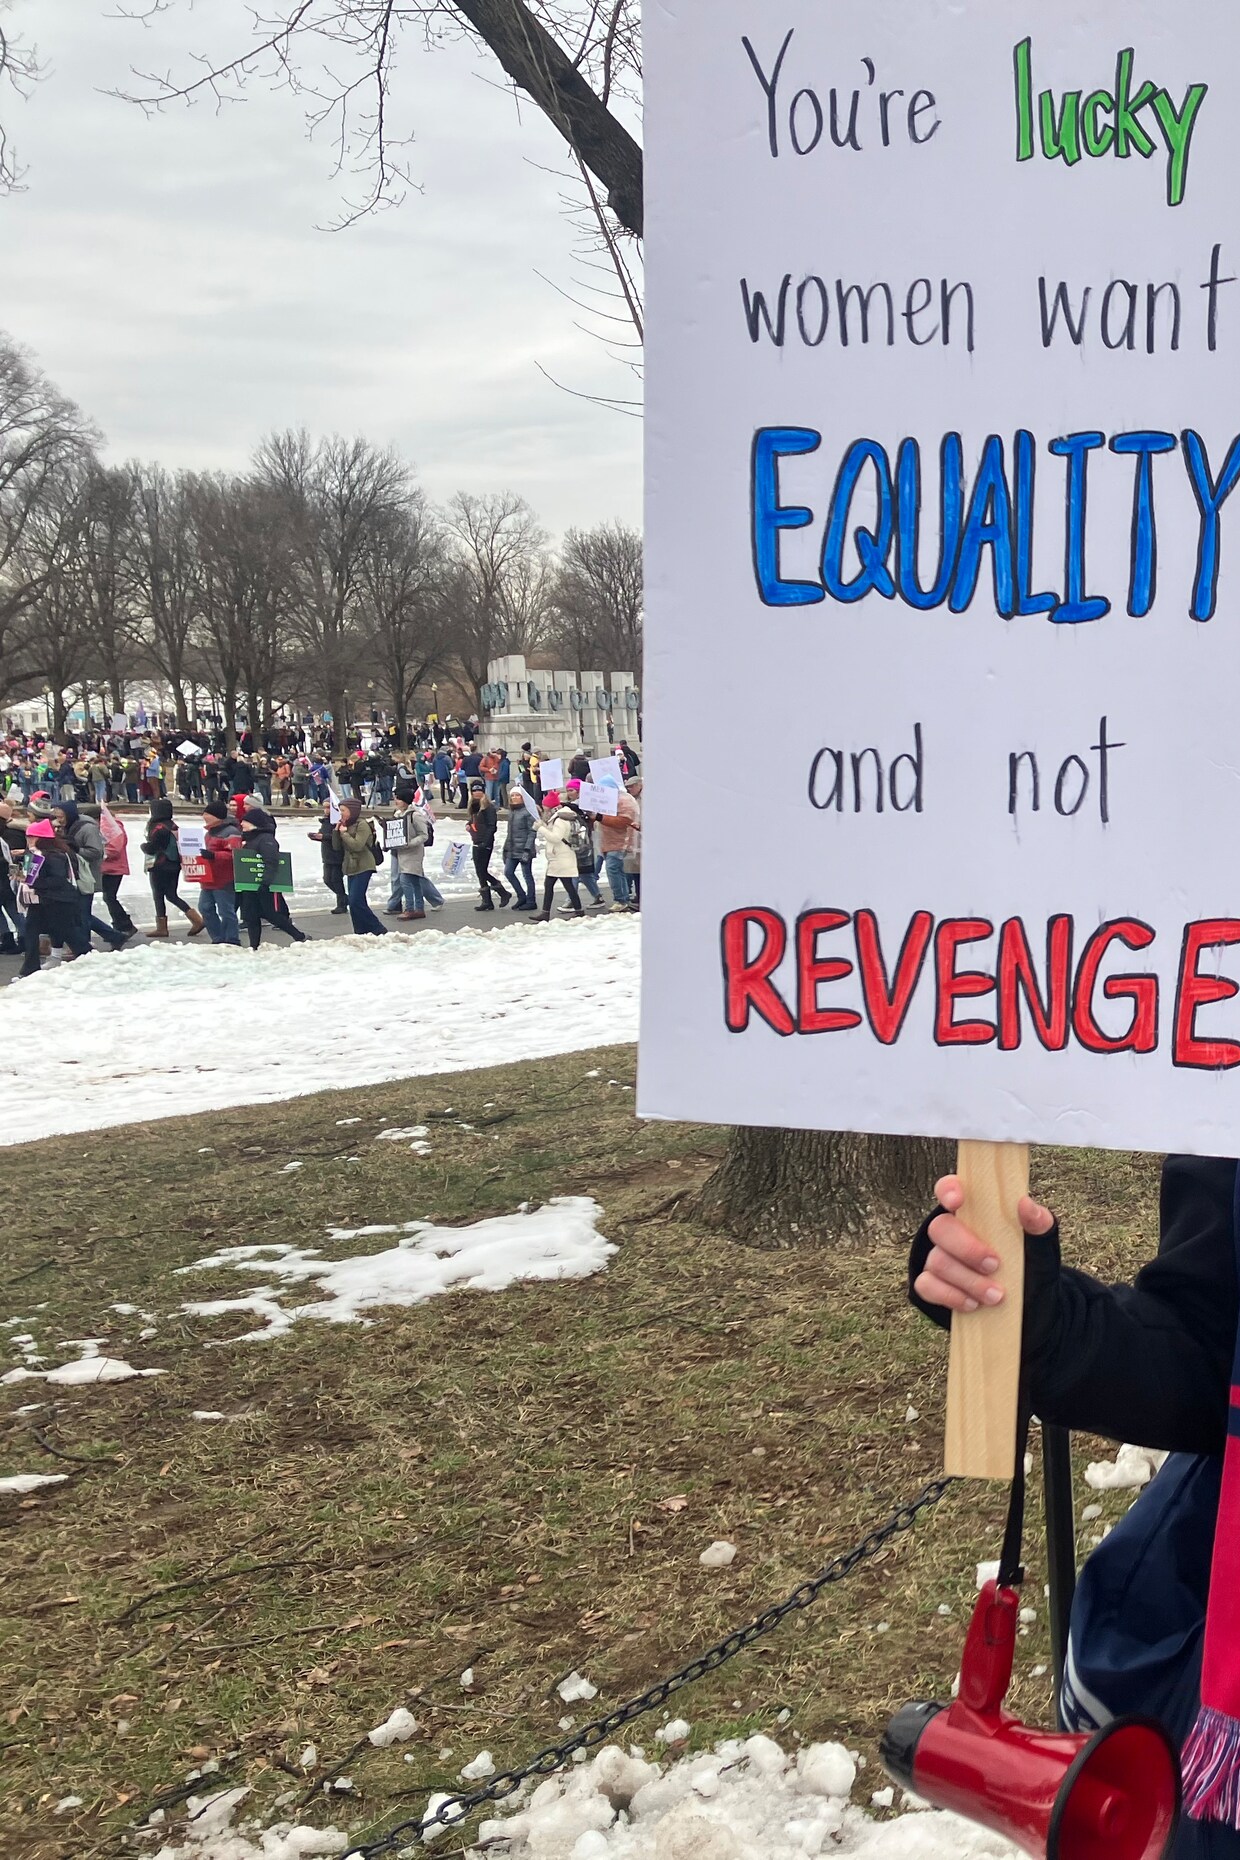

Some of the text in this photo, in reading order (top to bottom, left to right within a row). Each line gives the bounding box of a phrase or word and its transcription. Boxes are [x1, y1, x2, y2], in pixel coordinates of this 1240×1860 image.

[741, 28, 1208, 206] You're lucky
[740, 244, 1238, 353] women want
[807, 715, 1127, 823] and not
